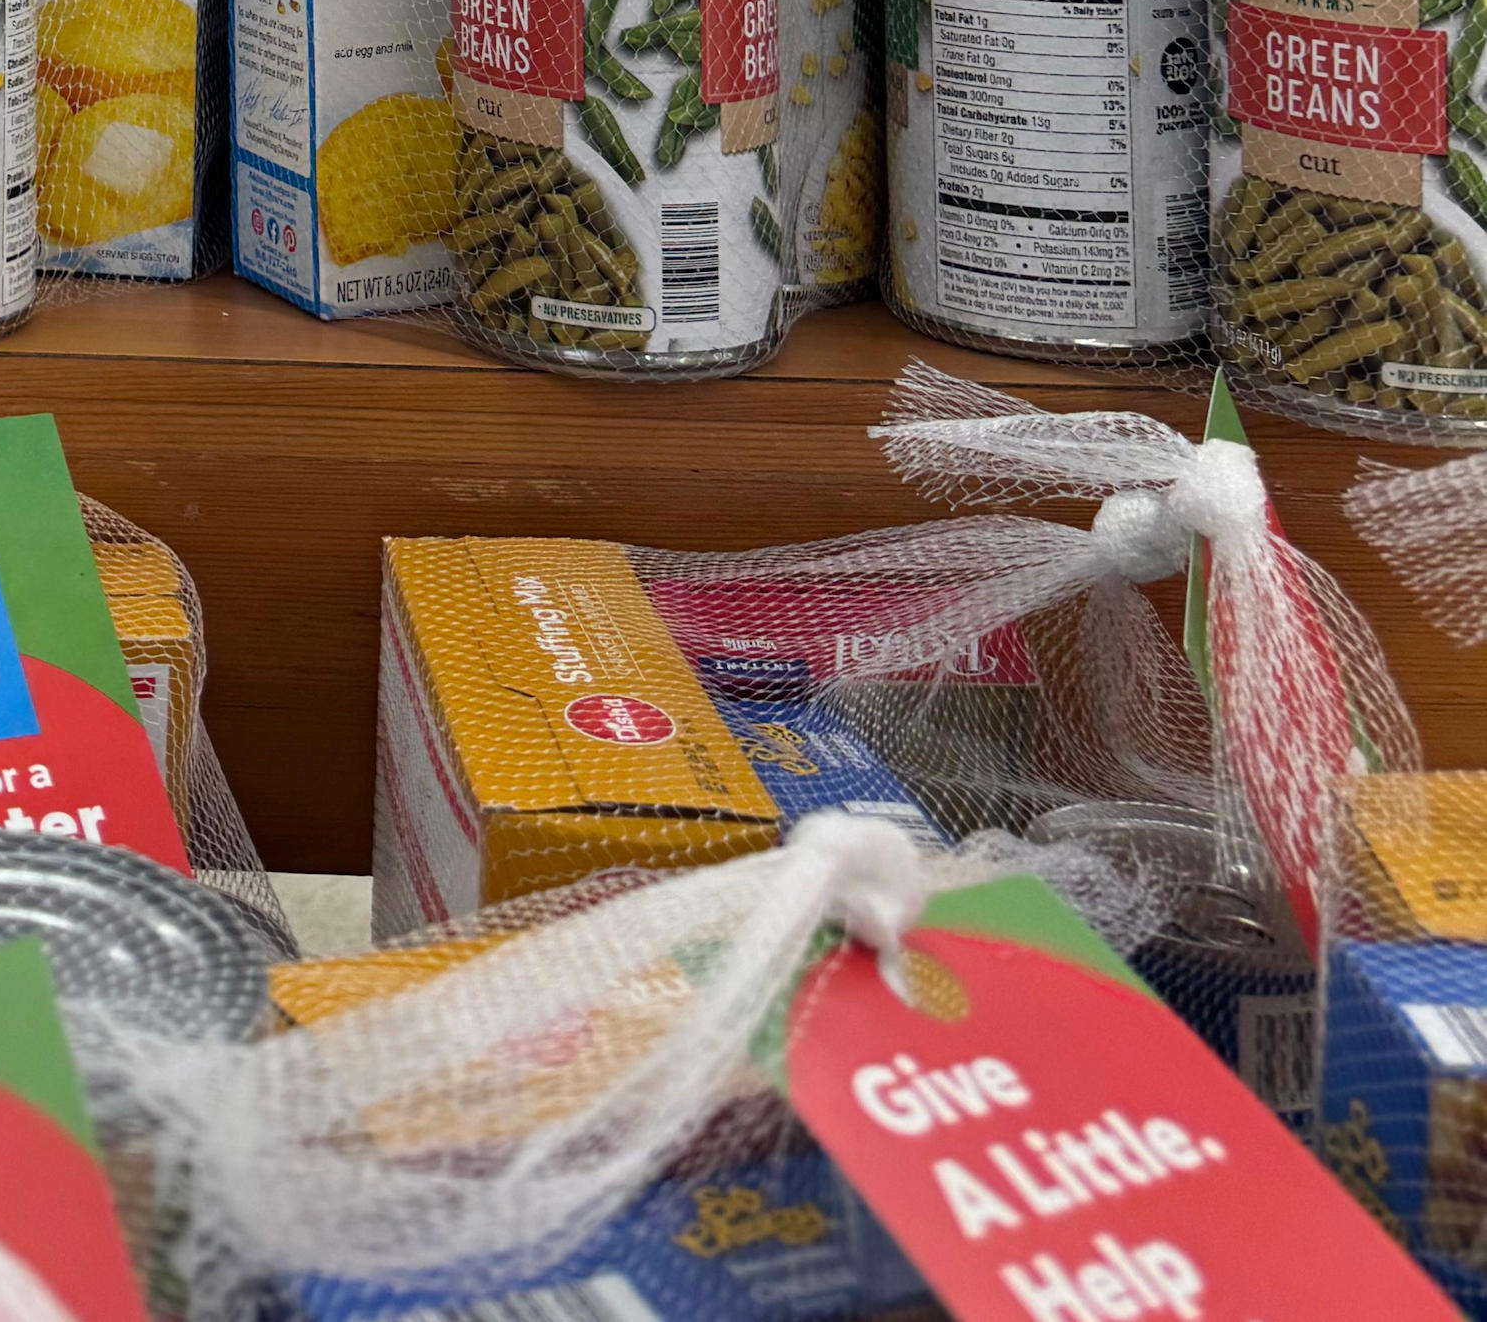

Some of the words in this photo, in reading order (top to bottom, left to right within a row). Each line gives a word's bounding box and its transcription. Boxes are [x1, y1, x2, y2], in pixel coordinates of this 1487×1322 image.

[459, 31, 531, 76] BEANS
[1266, 29, 1380, 85] GREEN
[1266, 78, 1381, 130] BEANS
[1299, 152, 1342, 177] cut
[561, 305, 644, 327] PRESERVATIVES
[514, 575, 550, 606] Mix
[533, 596, 594, 685] Stuffing
[30, 764, 53, 789] a
[852, 1053, 1033, 1137] Give
[933, 1157, 1023, 1242] A
[987, 1110, 1229, 1218] Little.
[1001, 1233, 1205, 1322] Help
